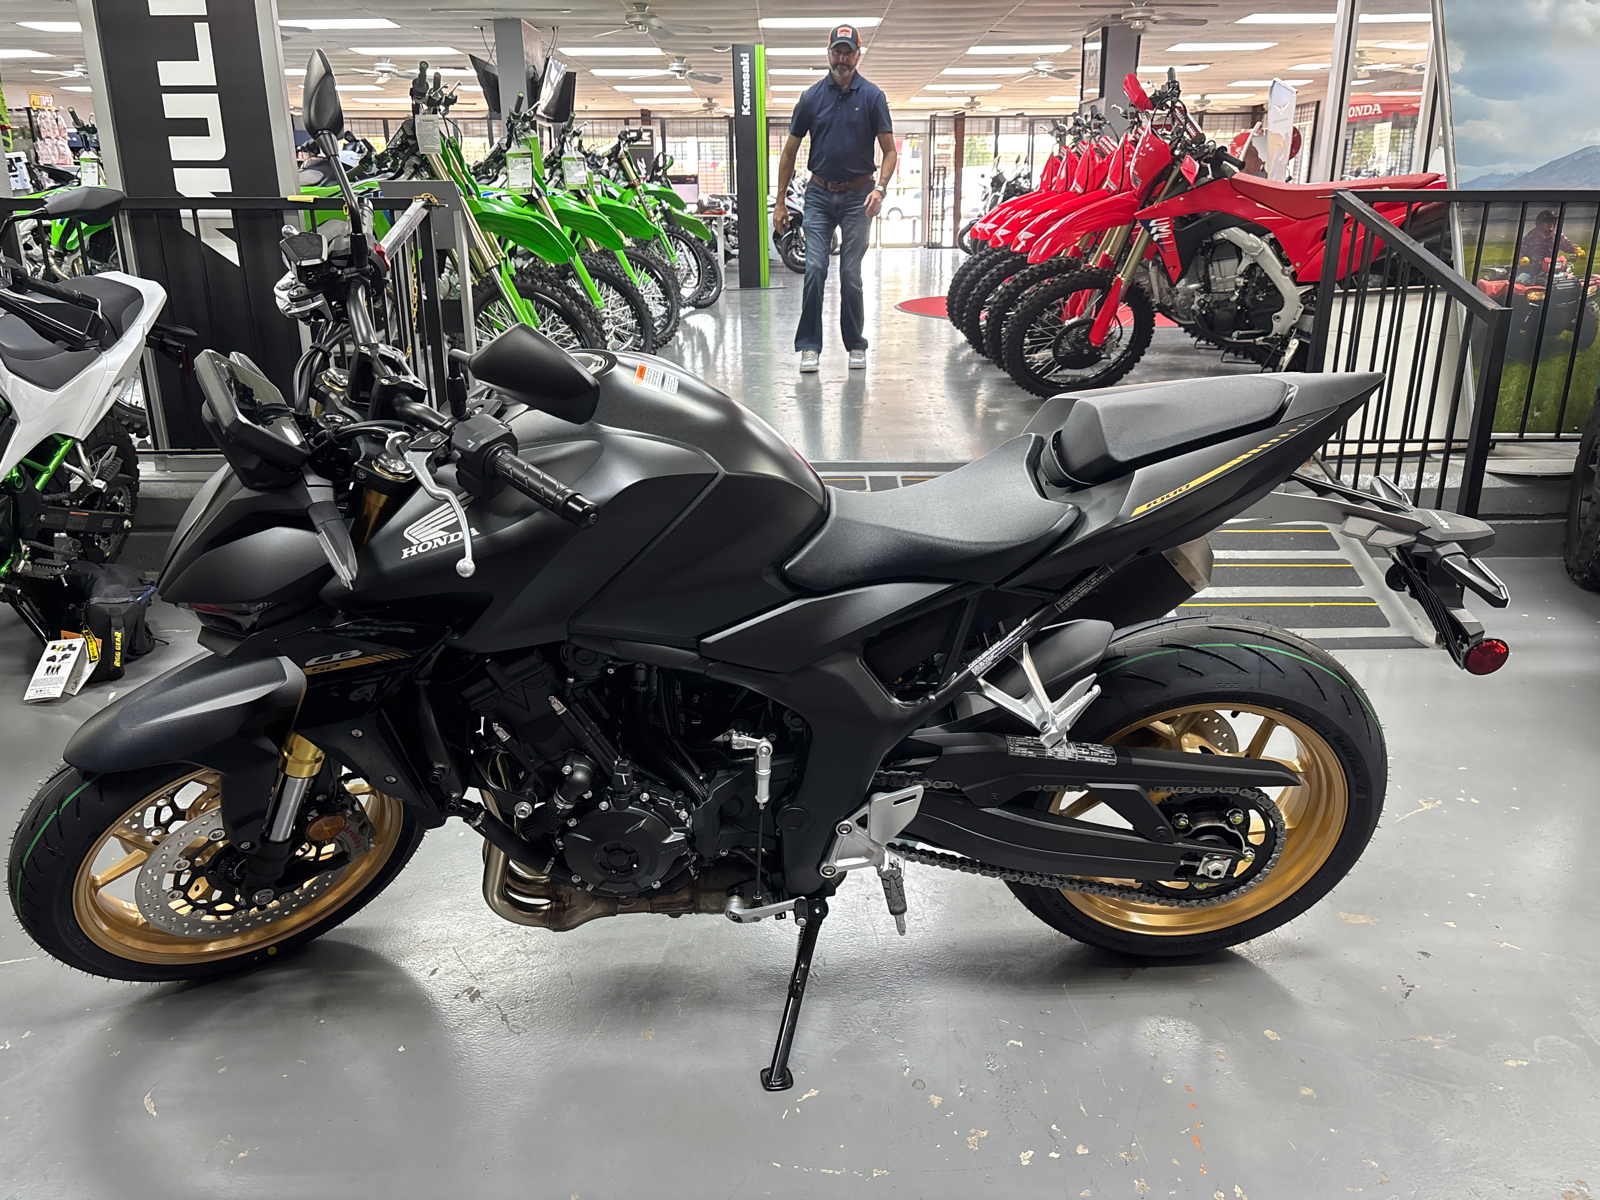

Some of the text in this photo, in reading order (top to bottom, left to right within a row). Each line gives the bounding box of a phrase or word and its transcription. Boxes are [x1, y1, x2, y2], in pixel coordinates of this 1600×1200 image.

[740, 52, 751, 116] Kawasaki
[1348, 103, 1383, 118] ONDA
[148, 0, 240, 268] MUL
[1149, 216, 1173, 242] CRF
[401, 527, 480, 559] HONDA
[113, 631, 122, 667] RIGG GEAR
[305, 649, 363, 666] CB
